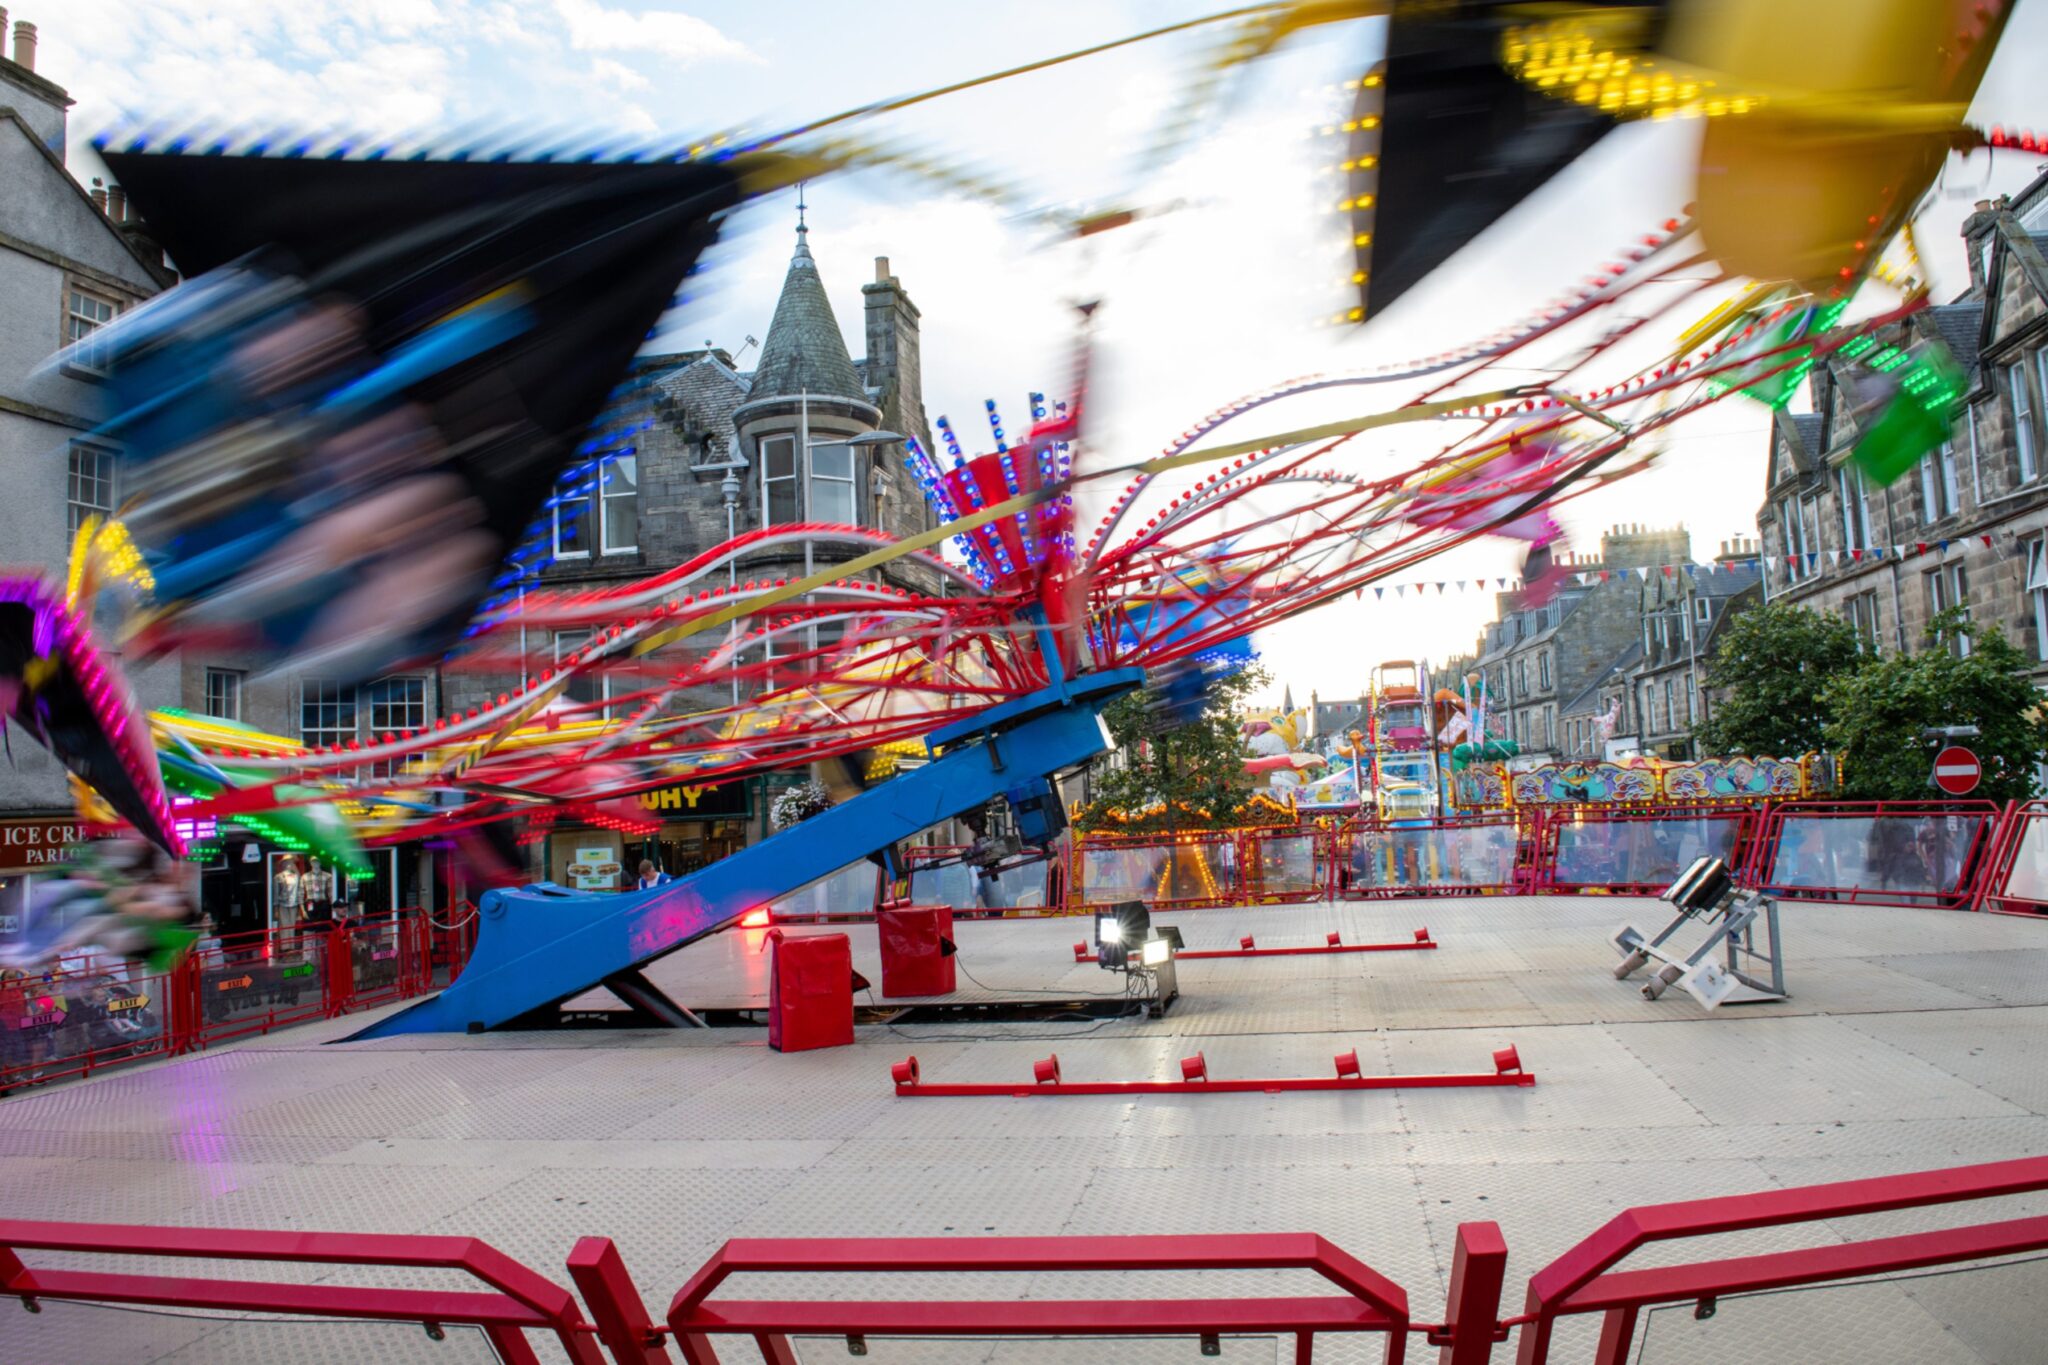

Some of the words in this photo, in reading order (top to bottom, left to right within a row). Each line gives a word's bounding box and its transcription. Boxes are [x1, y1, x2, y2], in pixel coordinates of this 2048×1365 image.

[4, 826, 41, 845] ICE
[26, 847, 86, 863] PARLO
[228, 979, 243, 988] EXIT
[119, 999, 138, 1009] EXIT
[32, 1014, 53, 1025] EXIT
